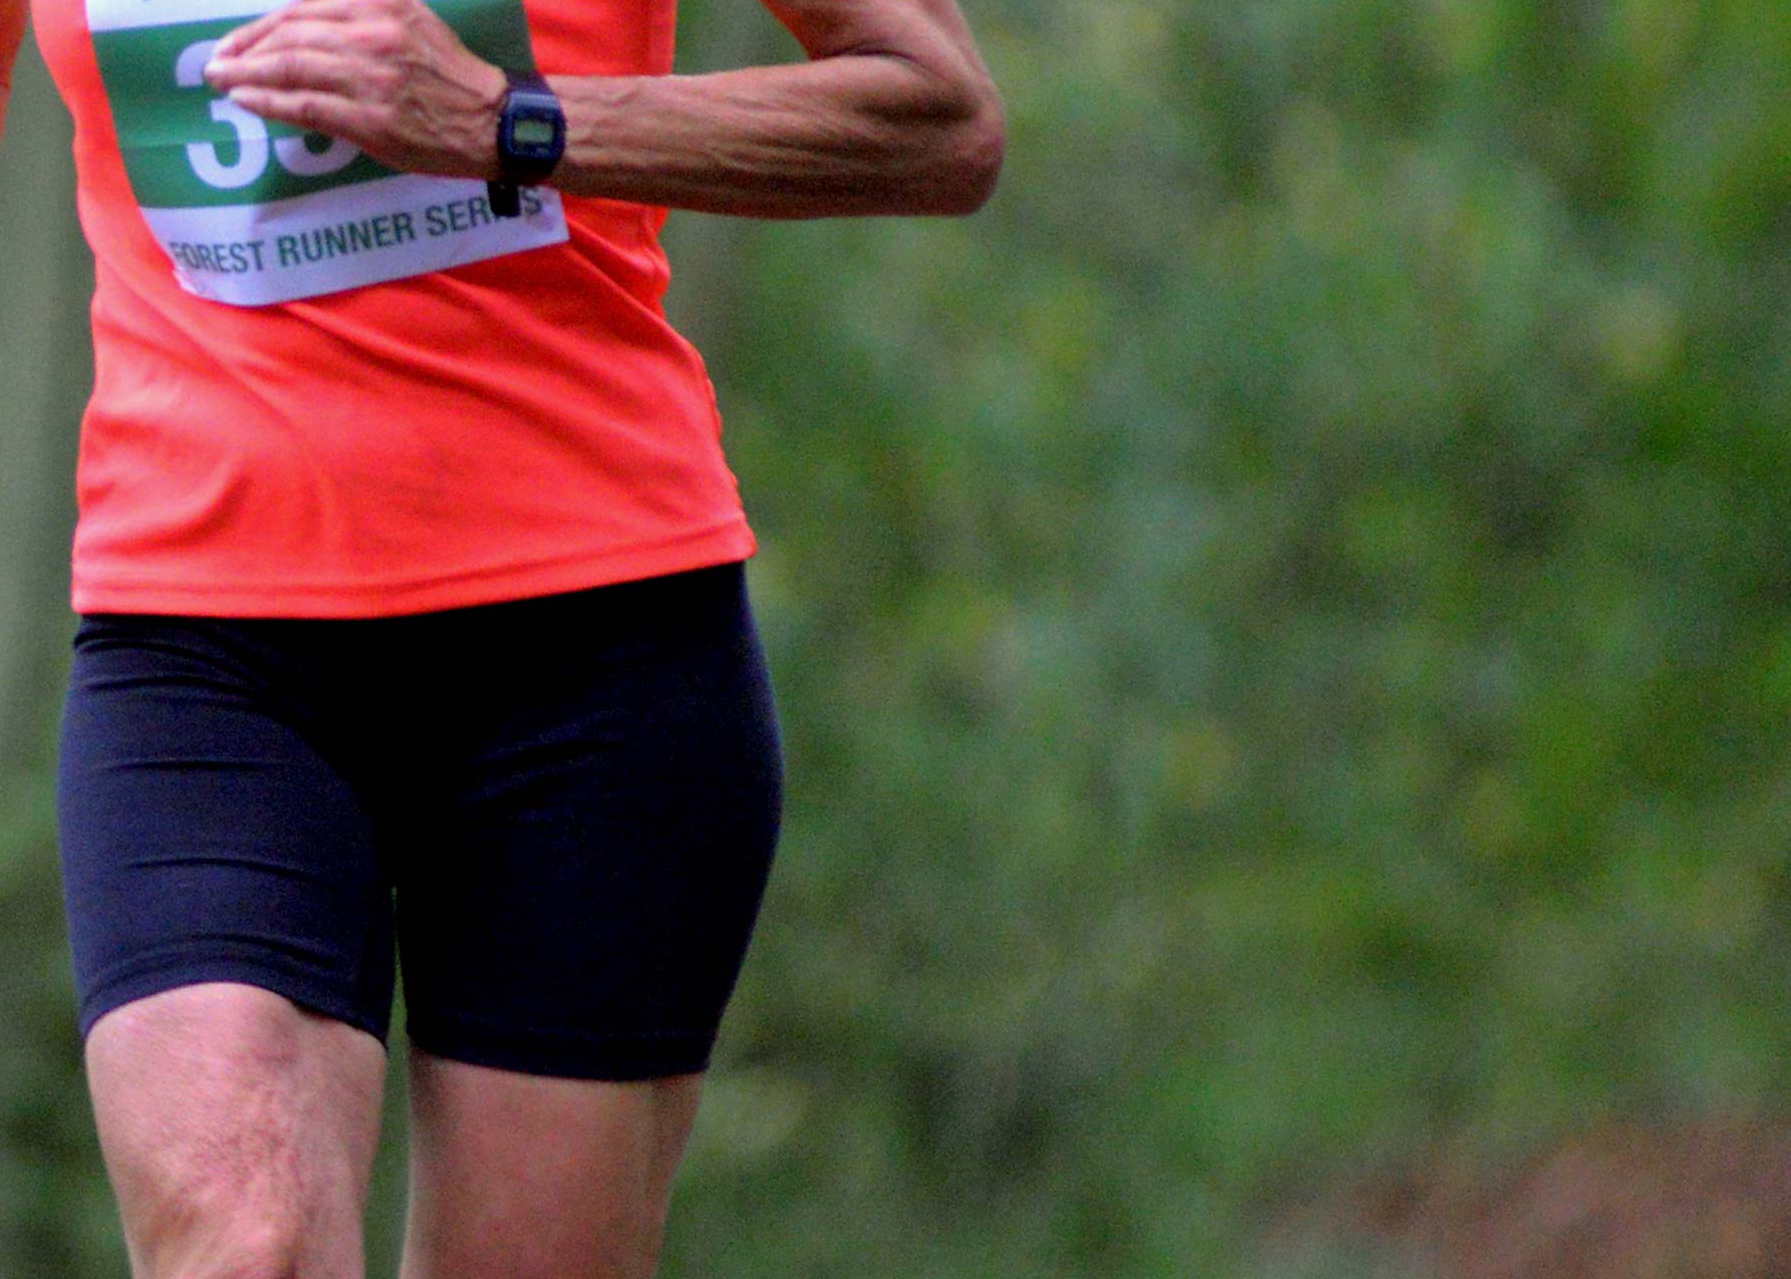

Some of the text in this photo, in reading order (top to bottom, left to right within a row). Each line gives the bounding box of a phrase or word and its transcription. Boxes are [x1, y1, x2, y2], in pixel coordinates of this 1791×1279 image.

[169, 188, 542, 273] FOREST RUNNER SERS
